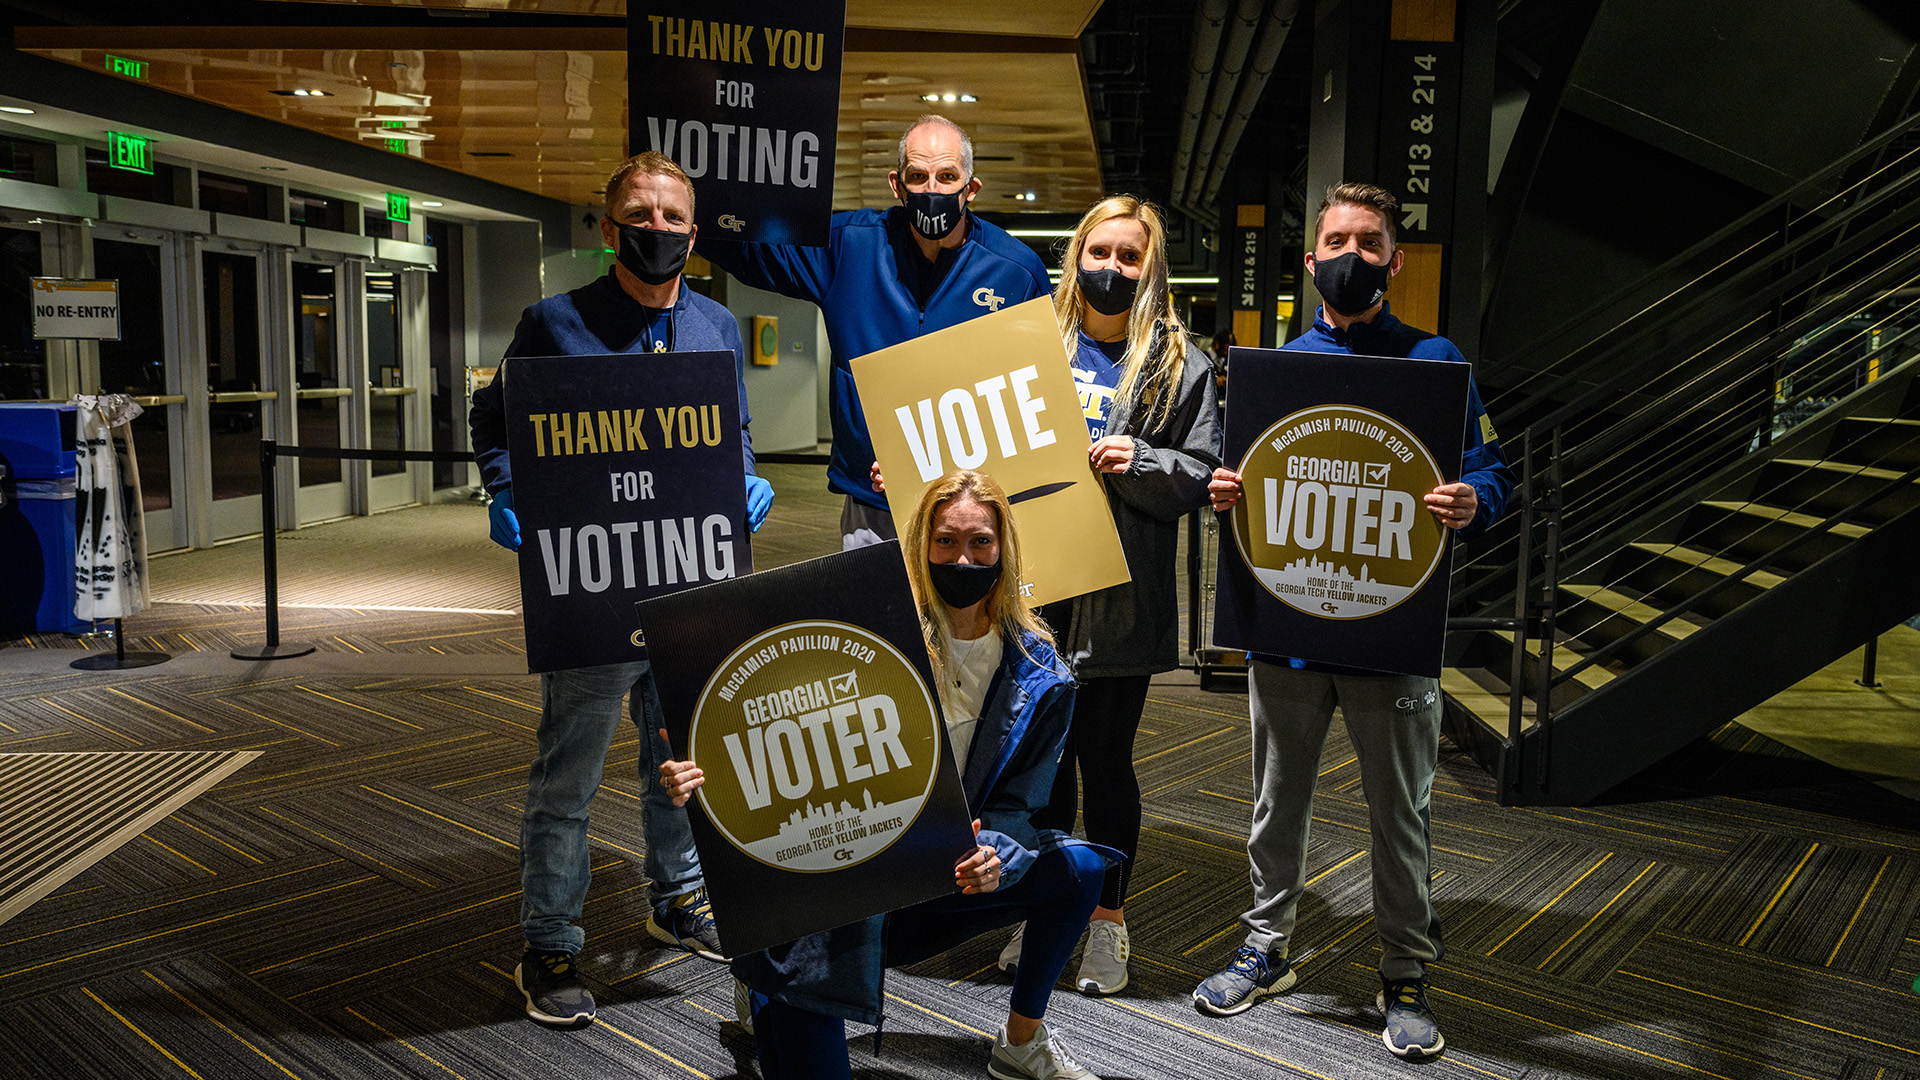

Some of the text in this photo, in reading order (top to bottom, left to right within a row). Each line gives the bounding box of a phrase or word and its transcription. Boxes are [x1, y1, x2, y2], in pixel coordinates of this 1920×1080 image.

[648, 15, 825, 72] THANK YOU
[715, 79, 755, 109] FOR
[1407, 54, 1437, 194] 213 & 214
[116, 135, 147, 169] EXIT
[647, 117, 820, 189] VOTING
[391, 195, 408, 220] EXIT
[718, 214, 745, 232] GT
[916, 209, 948, 235] VOTE
[1245, 231, 1257, 254] 215
[1243, 268, 1255, 291] 214
[36, 305, 116, 318] NO RE-ENTRY
[972, 287, 1005, 311] GT
[529, 404, 722, 457] THANK YOU
[894, 364, 1057, 483] VOTE
[1334, 417, 1387, 443] PAVILION
[1384, 435, 1415, 464] 2020
[1287, 455, 1360, 485] GEORGIA
[610, 470, 655, 502] FOR
[1264, 477, 1416, 561] VOTER
[537, 513, 736, 596] VOTING
[1275, 583, 1388, 606] GEORGIA TECH YELLOW JACKETS
[1307, 577, 1354, 592] HOME OF THE
[780, 635, 840, 655] PAVILION
[842, 639, 876, 664] 2020
[742, 680, 830, 726] GEORGIA
[722, 694, 912, 811] VOTER
[776, 816, 903, 862] GEORGIA TECH YELLOW JACKETS
[808, 815, 863, 840] HOME OF THE
